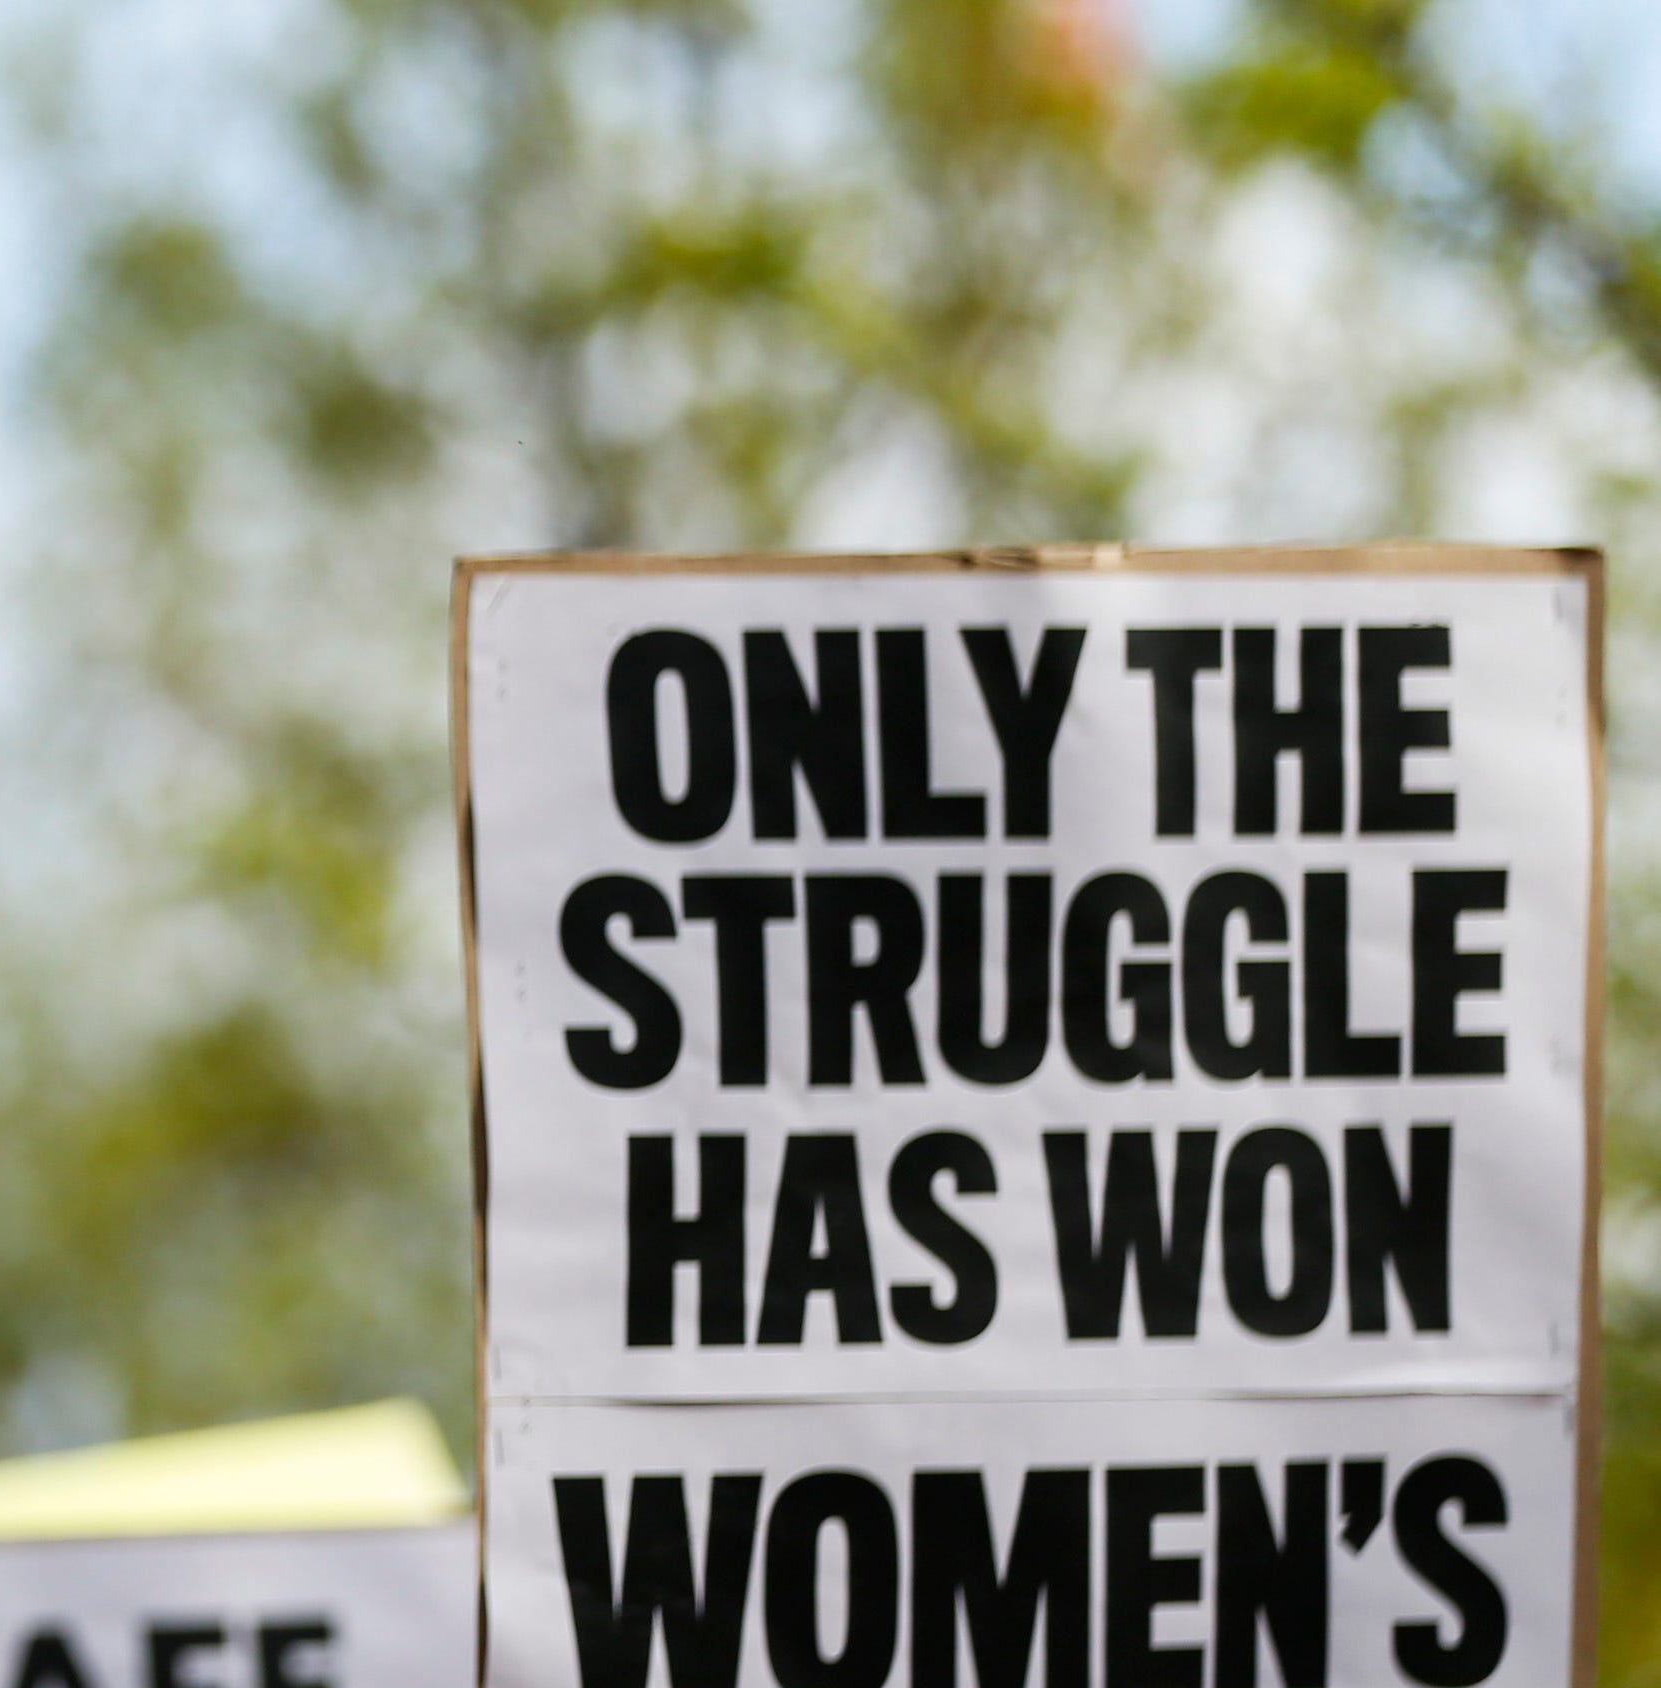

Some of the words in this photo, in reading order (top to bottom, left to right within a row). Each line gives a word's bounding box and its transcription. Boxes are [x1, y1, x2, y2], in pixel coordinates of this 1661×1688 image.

[605, 626, 1087, 846] ONLY
[1125, 624, 1458, 838] THE
[557, 868, 1509, 1092] STRUGGLE
[625, 1128, 999, 1348] HAS
[1041, 1124, 1454, 1340] WON
